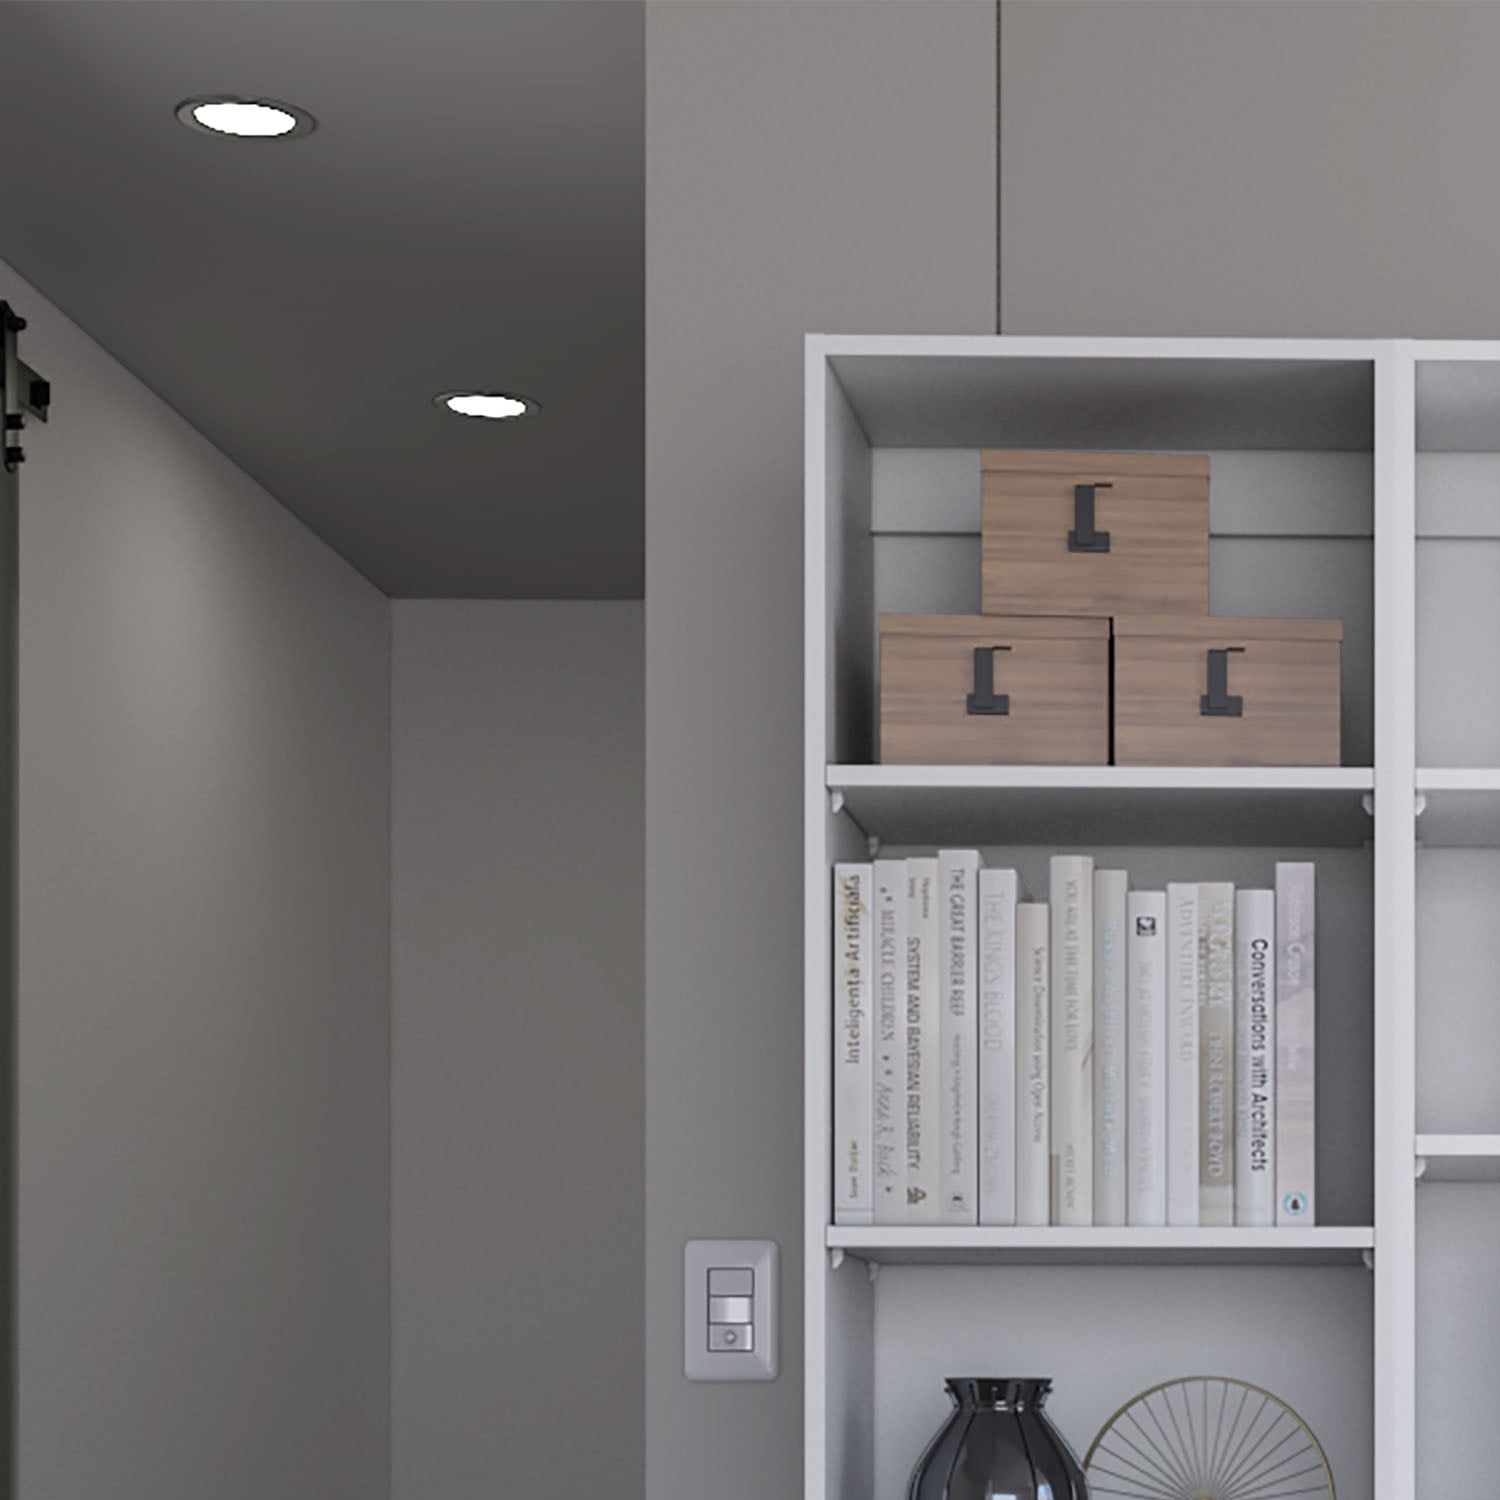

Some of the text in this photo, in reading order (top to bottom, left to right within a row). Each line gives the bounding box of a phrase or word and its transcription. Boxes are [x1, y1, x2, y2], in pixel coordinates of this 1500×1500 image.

[880, 908, 896, 1042] MIRACLE CHILDREN
[950, 868, 965, 1016] THE GREAT BARRIER REEF
[983, 891, 1005, 1051] THE BLOOD
[907, 936, 920, 1169] SYSTEM AND BAYESIAN RELIABILITY
[1207, 1078, 1224, 1130] ROBERT
[1252, 938, 1268, 1171] Conversations with Architects
